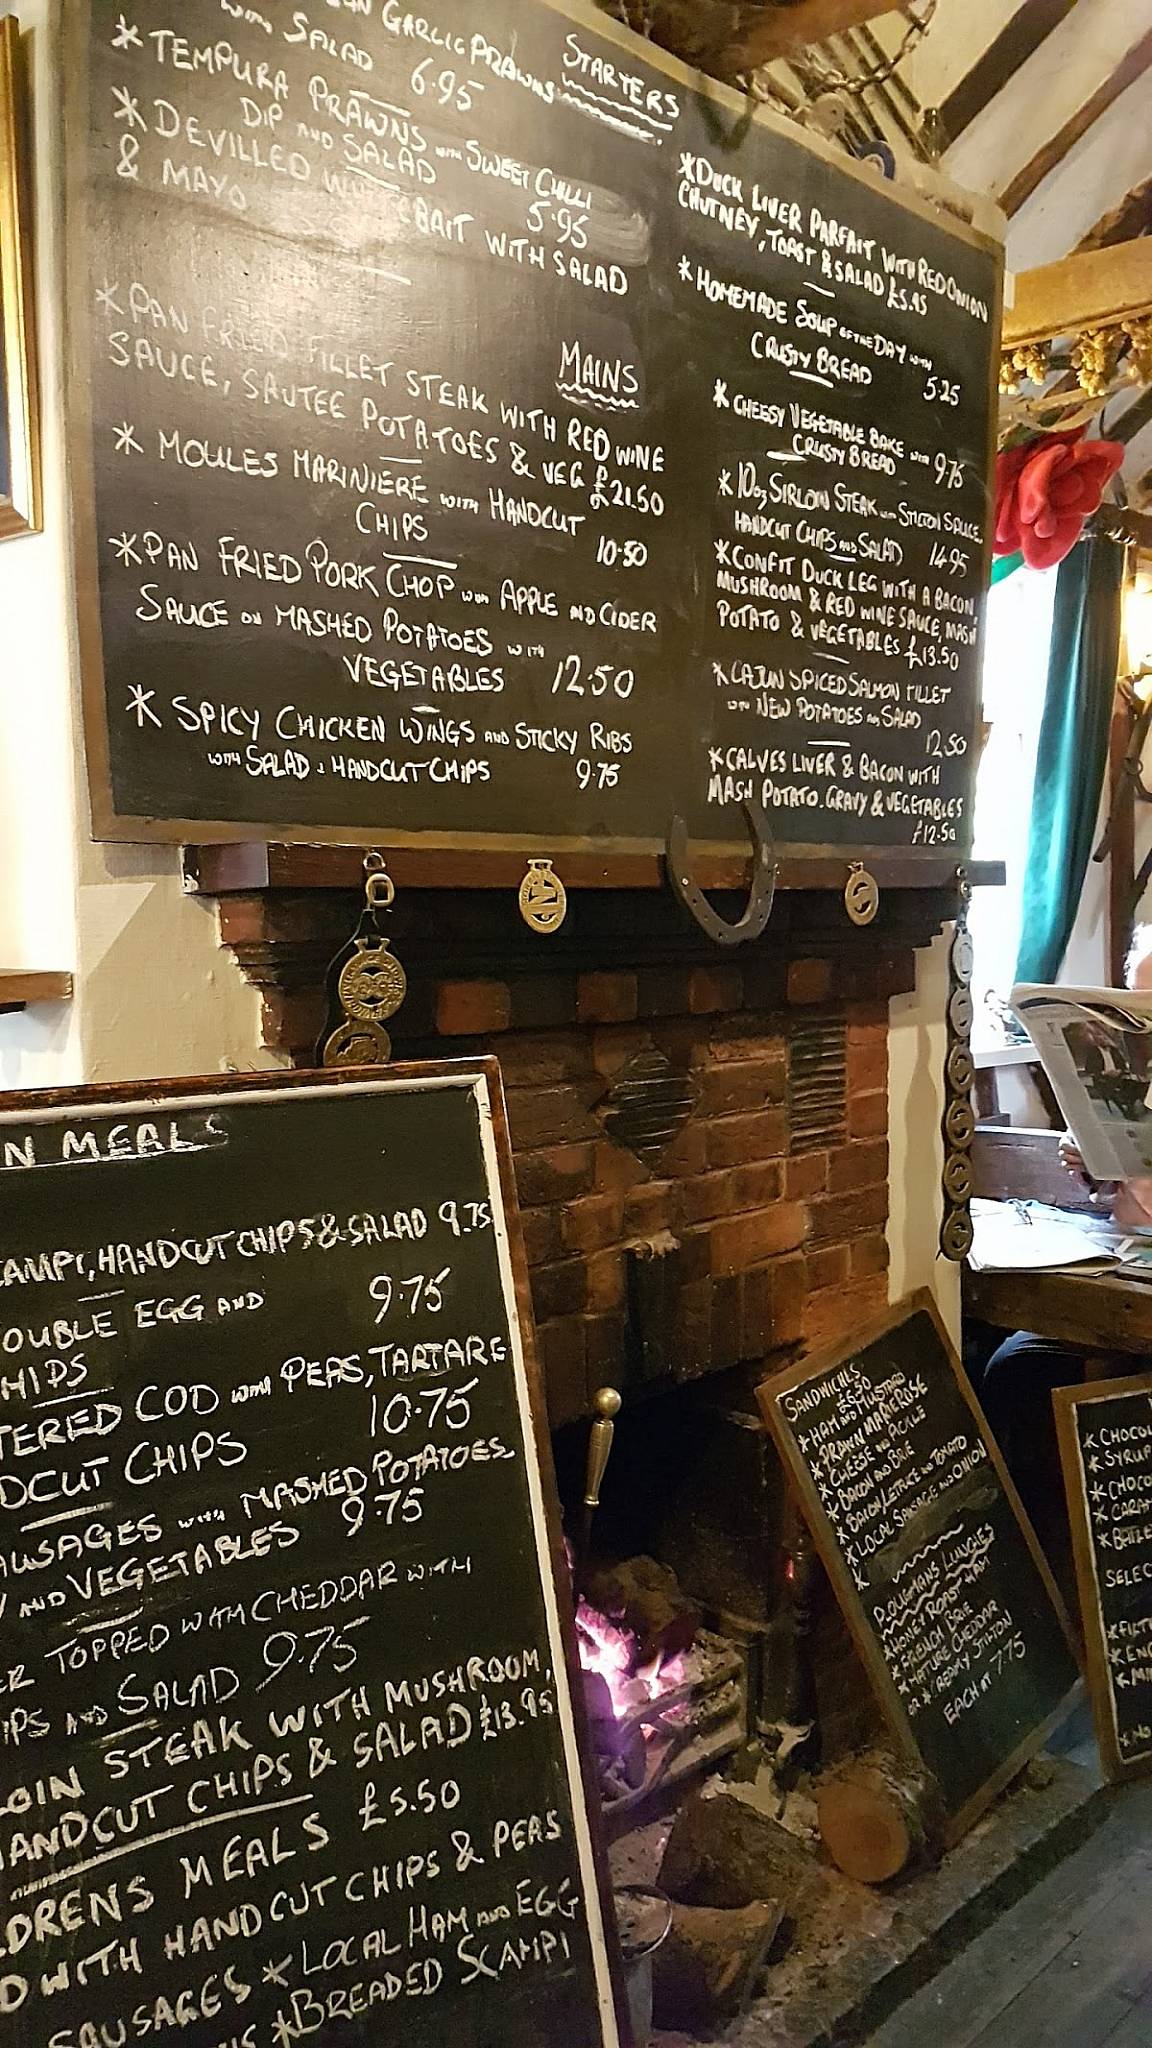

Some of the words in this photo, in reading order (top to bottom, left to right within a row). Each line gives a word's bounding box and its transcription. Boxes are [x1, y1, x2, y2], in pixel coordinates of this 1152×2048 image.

[284, 11, 373, 71] SALAD
[410, 58, 484, 111] 6.95
[382, 1, 464, 54] GARLIC
[563, 34, 679, 117] STARTERS
[149, 30, 288, 100] TEMPURA
[308, 75, 427, 151] PRAWNS
[466, 140, 529, 189] SWEET
[535, 168, 591, 209] CHILLI
[117, 134, 139, 181] &
[162, 159, 246, 210] MAYO
[154, 100, 310, 181] DEVILLED
[485, 230, 545, 269] WITH
[553, 251, 628, 295] SALAD
[241, 97, 283, 130] DIP
[342, 133, 437, 185] SALAD
[527, 201, 589, 249] 5.95
[696, 157, 744, 202] DUCK
[752, 184, 802, 233] LIVER
[811, 208, 876, 260] PARFAIT
[697, 266, 788, 325] HOMEMADE
[795, 299, 837, 337] SOUP
[835, 259, 884, 296] SALAD
[130, 283, 188, 334] PAN
[310, 336, 393, 386] FILLET
[406, 369, 489, 414] STEAK
[500, 401, 556, 442] WITH
[567, 419, 611, 461] RED
[616, 446, 665, 472] WINE
[559, 341, 639, 393] MAINS
[817, 347, 872, 385] BREAD
[923, 376, 961, 407] 5.25
[108, 331, 230, 395] SAUCE,
[242, 368, 346, 419] SAUTEE
[361, 397, 499, 465] POTATOES
[509, 442, 536, 478] &
[543, 462, 585, 488] VEG
[590, 465, 664, 516] £21.50
[789, 403, 865, 445] VEGETABLE
[870, 428, 904, 458] BAKE
[159, 430, 279, 477] MOULES
[293, 449, 429, 505] MARINIERE
[489, 488, 586, 536] HANDCUT
[849, 444, 895, 476] BREAD
[356, 501, 429, 542] CHIPS
[735, 510, 791, 540] HANDCUT
[835, 483, 878, 517] STEAK
[143, 531, 199, 570] PAN
[218, 536, 302, 584] FRIED
[306, 539, 379, 598] PORK
[386, 563, 455, 599] CHOP
[500, 579, 558, 617] APPLE
[599, 602, 657, 633] CIDER
[717, 570, 802, 601] MUSHROOM
[826, 594, 855, 618] RED
[732, 546, 795, 575] CONFIT
[802, 559, 843, 589] DUCK
[848, 572, 876, 592] LEG
[882, 580, 915, 601] WITH
[136, 583, 229, 628] SAUCE
[275, 604, 372, 643] MASHED
[383, 607, 493, 657] POTATOES
[717, 600, 780, 631] POTATO
[810, 623, 899, 655] VEGETABLES
[904, 636, 959, 670] £13.50
[343, 653, 505, 693] VEGETABLES
[552, 655, 634, 698] 12.50
[732, 663, 784, 690] CAJUN
[790, 669, 846, 692] SPICED
[757, 692, 791, 718] NEW
[797, 697, 863, 726] POTATOES
[883, 705, 921, 729] SALAD
[172, 696, 259, 740] SPICY
[276, 706, 385, 742] CHICKEN
[400, 717, 475, 746] WINGS
[515, 722, 577, 755] STICKY
[590, 722, 633, 753] RIBS
[245, 745, 310, 778] SALAD
[576, 759, 620, 789] 9.75
[726, 747, 786, 773] CALVES
[792, 753, 835, 777] LIVER
[860, 753, 904, 782] BACON
[908, 766, 939, 785] WITH
[708, 775, 752, 805] MASH
[887, 794, 964, 820] VEGETABLES
[100, 1231, 235, 1275] HANDCUT
[349, 1208, 427, 1247] SALAD
[135, 1294, 204, 1328] EGG
[218, 1292, 264, 1316] AND
[369, 1268, 450, 1324] 9.75
[136, 1385, 219, 1421] COD
[280, 1355, 374, 1392] PEAS,
[368, 1336, 506, 1378] TARTARE
[124, 1432, 247, 1484] CHIPS
[371, 1378, 479, 1437] 10.75
[809, 1415, 840, 1446] HAM
[840, 1410, 857, 1426] AND
[819, 1428, 866, 1471] PRAWN
[240, 1466, 367, 1518] MASHED
[830, 1444, 876, 1486] CHEESE
[838, 1474, 874, 1511] BACON
[888, 1441, 916, 1469] BRIE
[857, 1521, 895, 1556] LOCAL
[951, 1438, 988, 1479] ONION
[66, 1521, 300, 1599] VEGETABLES
[341, 1487, 424, 1536] 9.75
[44, 1624, 170, 1674] TOPPED
[182, 1603, 246, 1633] WITH
[251, 1560, 397, 1622] CHEDDAR
[890, 1614, 926, 1652] HONEY
[926, 1578, 962, 1620] ROAST
[965, 1556, 991, 1583] HAM
[118, 1667, 240, 1715] SALAD
[256, 1616, 371, 1693] 9.75
[104, 1717, 254, 1778] STEAK
[268, 1687, 371, 1737] WITH
[943, 1681, 980, 1725] EACH
[187, 1753, 292, 1814] CHIPS
[309, 1737, 336, 1778] &
[354, 1703, 472, 1768] SALAD
[179, 1812, 329, 1899] MEALS
[359, 1780, 460, 1831] £5.50
[41, 1938, 143, 1996] WITH
[345, 1850, 440, 1901] CHIPS
[451, 1830, 484, 1871] &
[494, 1810, 561, 1857] PEAS
[303, 1929, 401, 1976] LOCAL
[409, 1905, 468, 1947] HAM
[516, 1878, 579, 1919] EGG
[291, 1958, 442, 2035] BREADED
[457, 1931, 570, 1984] SCAMPI
